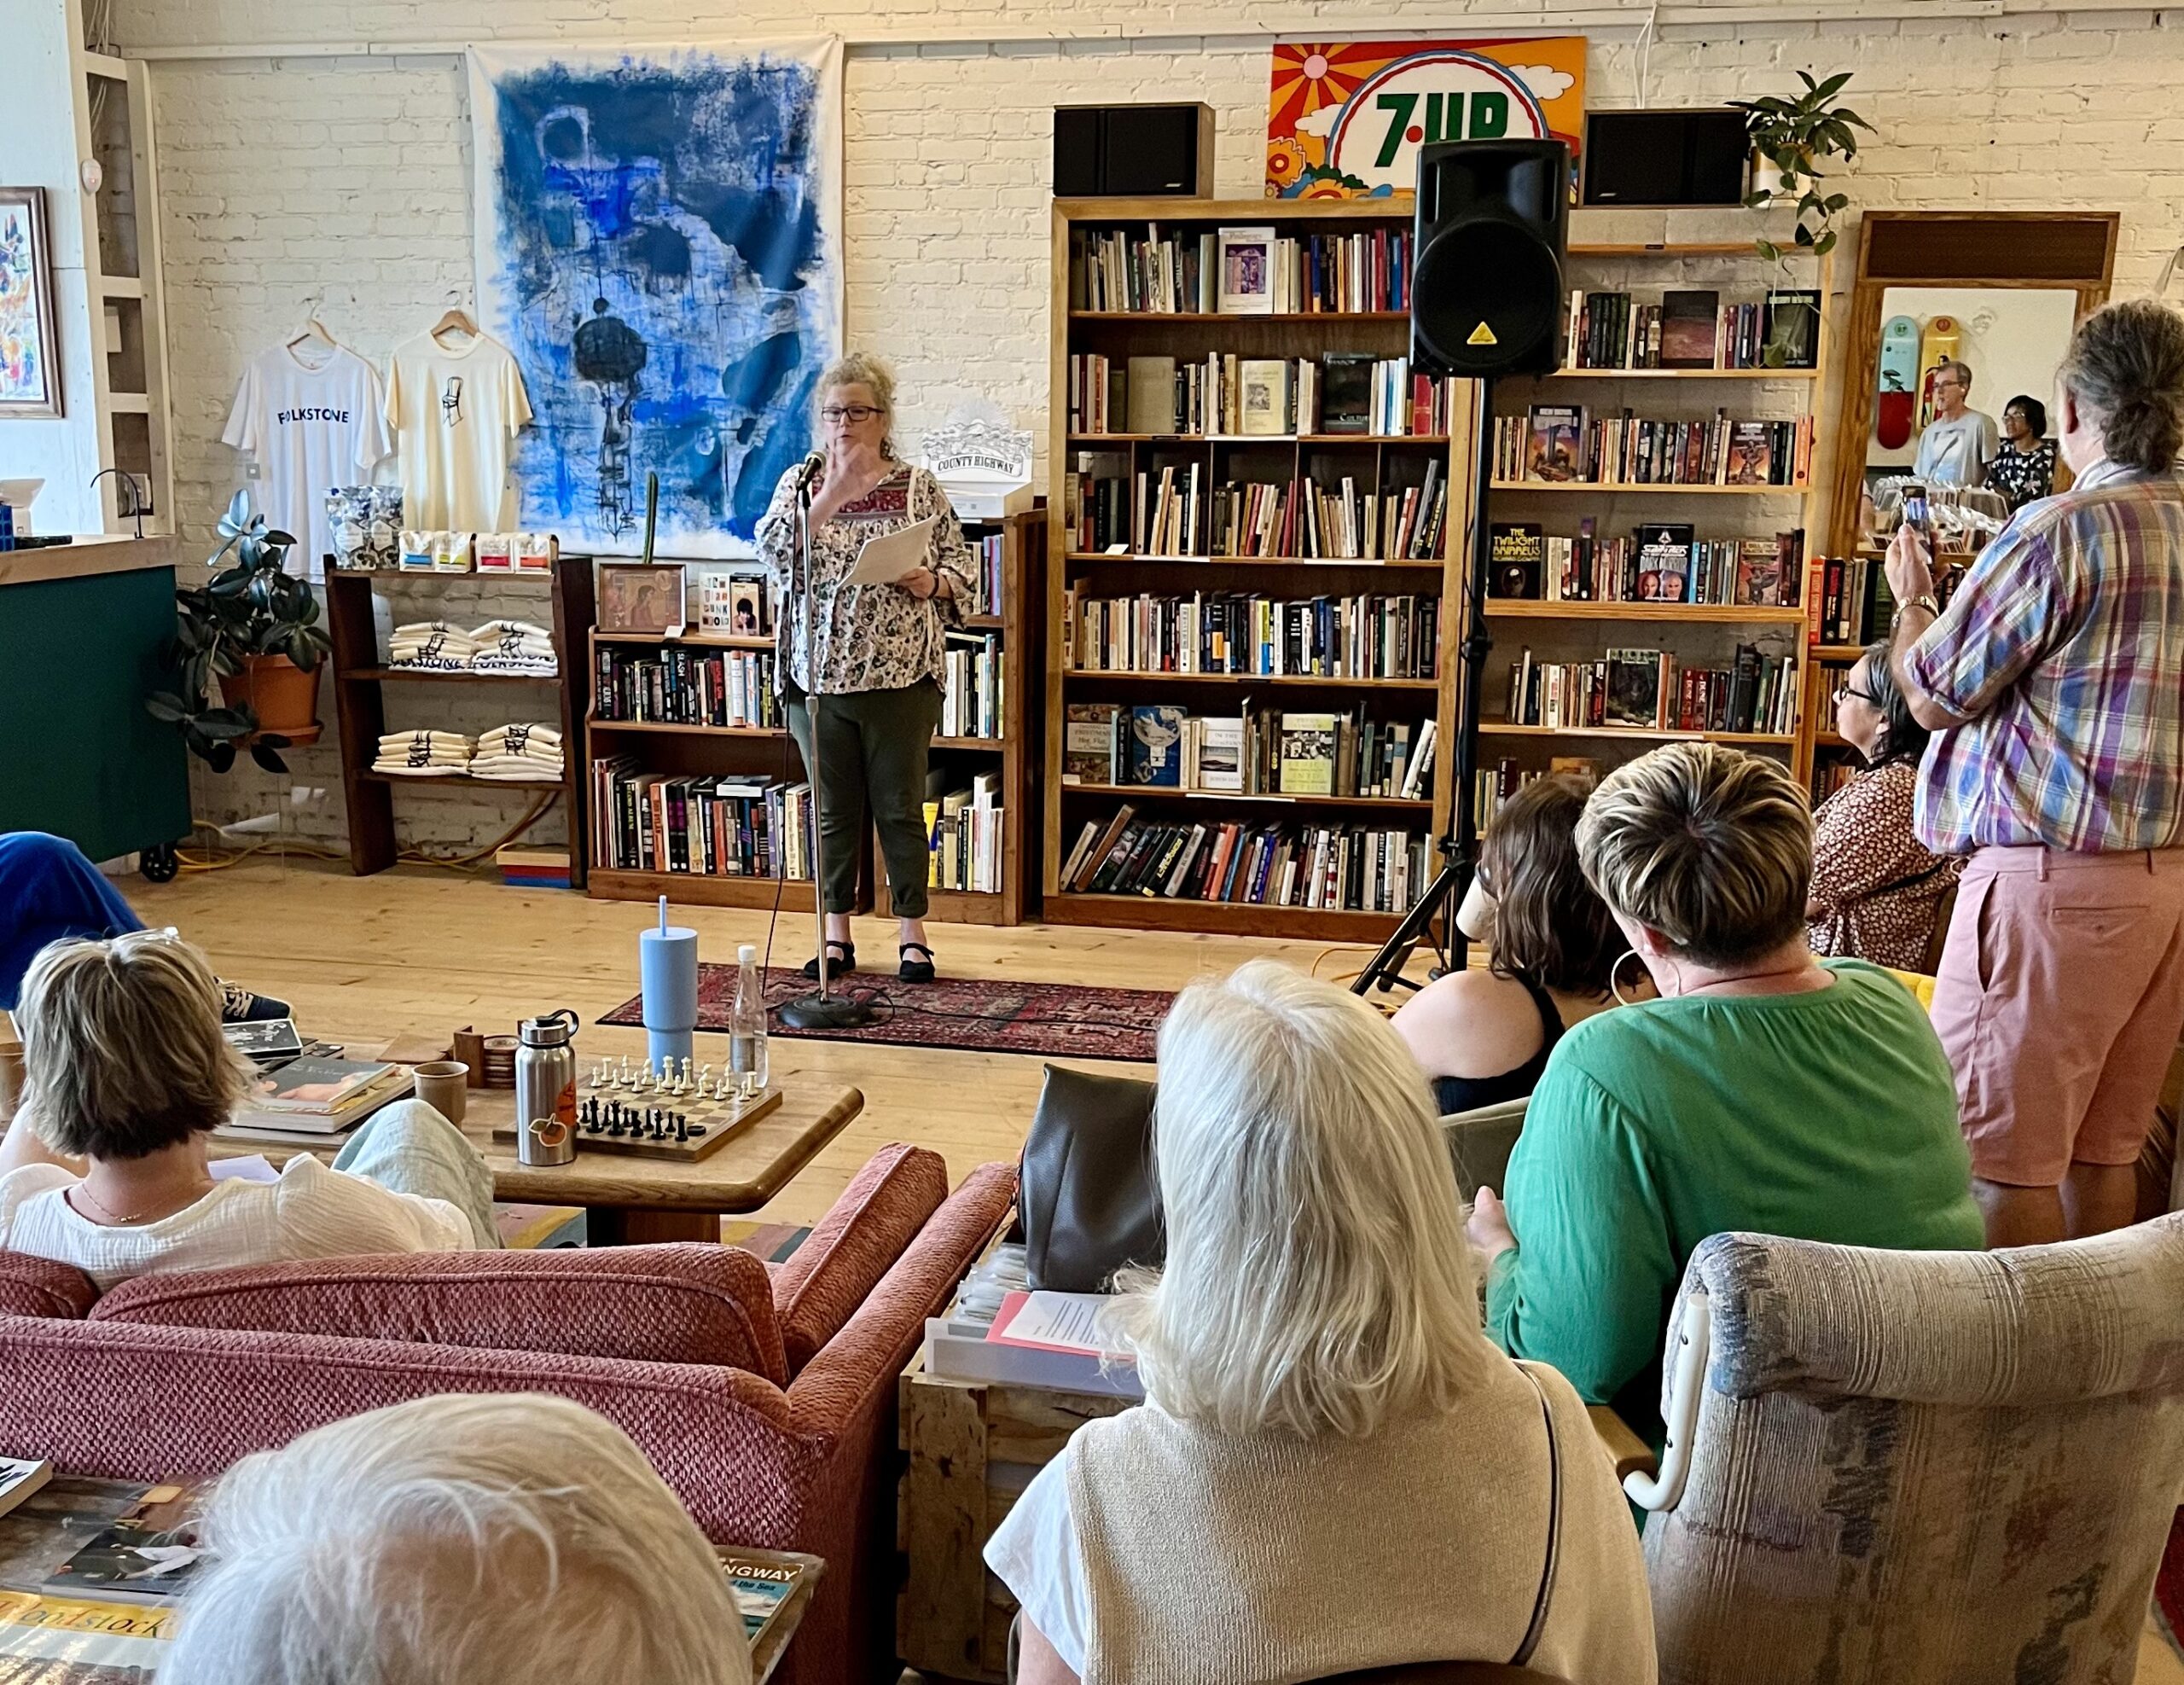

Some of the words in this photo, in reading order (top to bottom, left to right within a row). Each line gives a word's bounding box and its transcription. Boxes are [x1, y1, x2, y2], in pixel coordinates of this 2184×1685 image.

[277, 407, 350, 425] FOLKSTONE
[938, 456, 973, 471] COUNTY
[974, 456, 1014, 474] HIGHWAY
[1494, 536, 1541, 546] TWILIGHT
[1510, 528, 1525, 537] THE
[677, 653, 686, 677] SLASH
